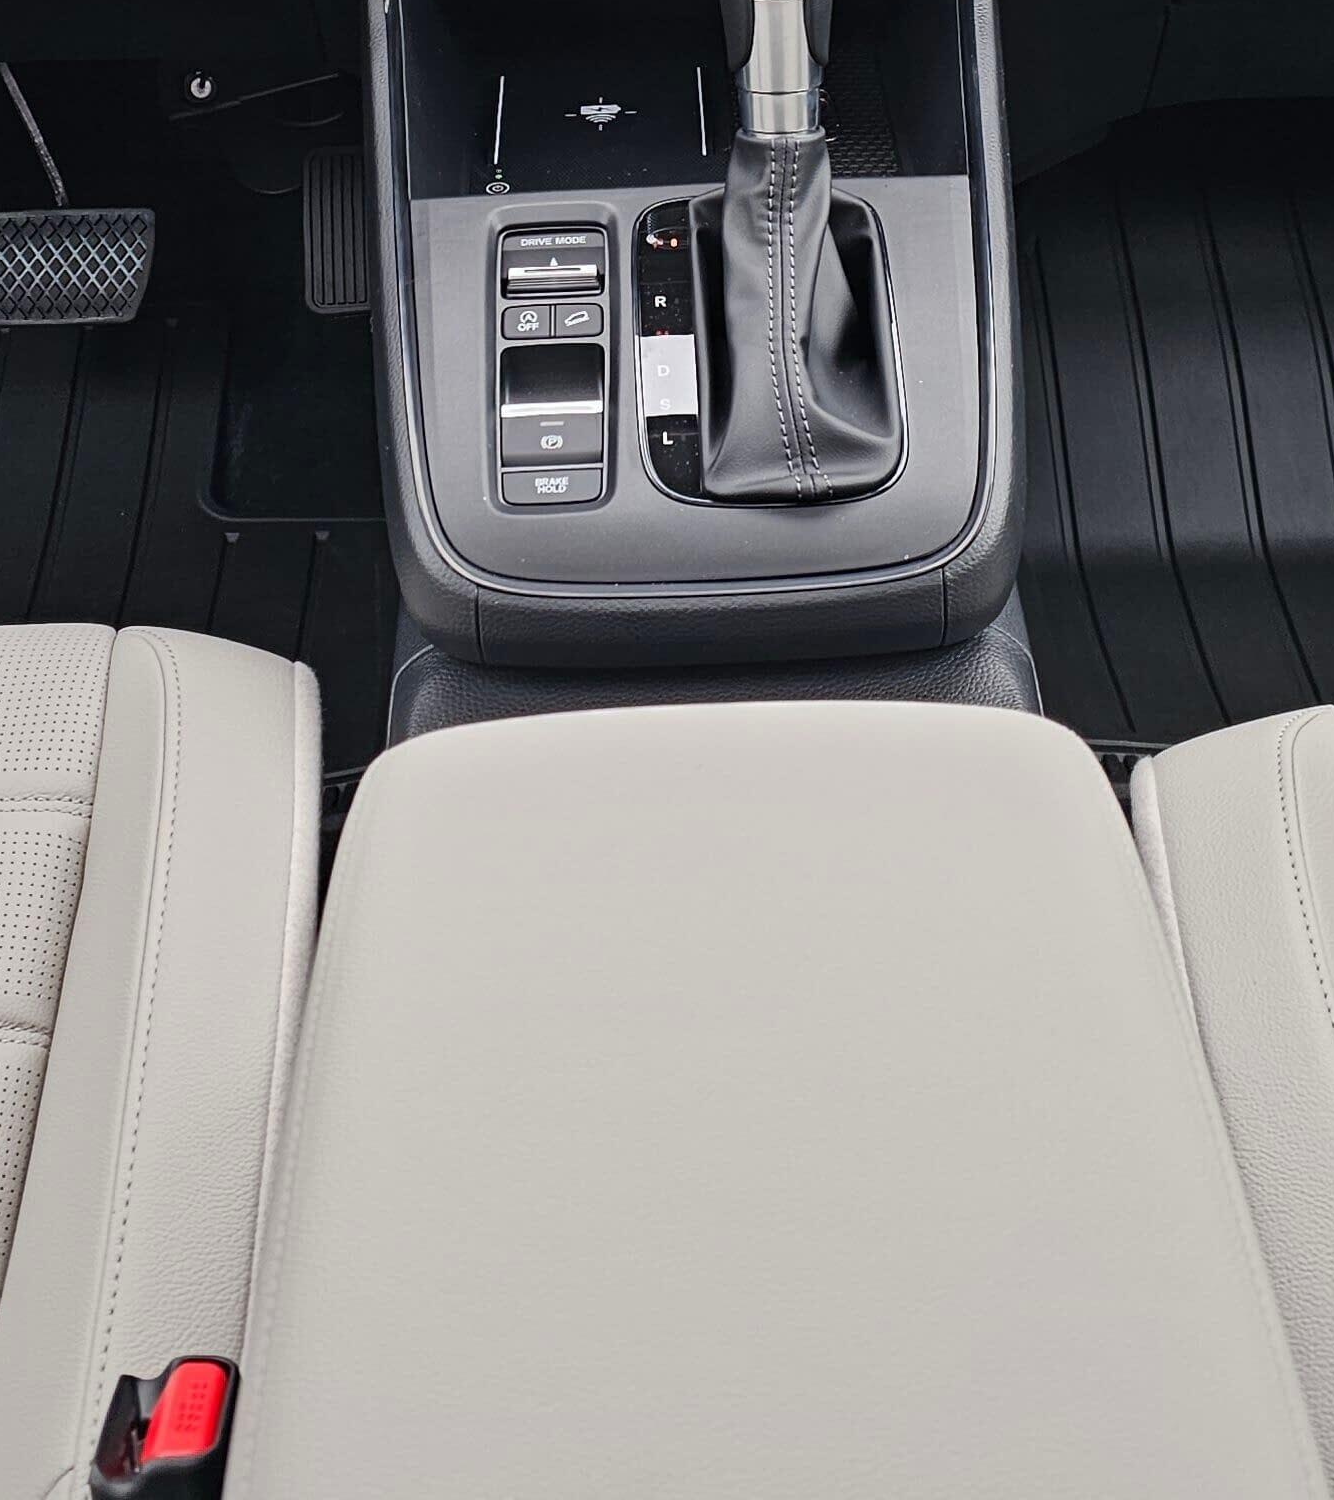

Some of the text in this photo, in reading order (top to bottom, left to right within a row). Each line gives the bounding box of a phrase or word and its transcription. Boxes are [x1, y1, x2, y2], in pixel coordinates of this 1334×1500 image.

[520, 235, 587, 247] DRIVE MODE
[654, 295, 667, 308] R
[517, 322, 539, 332] OFF
[657, 364, 670, 377] D
[660, 398, 671, 411] S
[662, 431, 674, 445] L
[535, 476, 569, 487] BRAKE
[537, 485, 567, 494] HOLD
